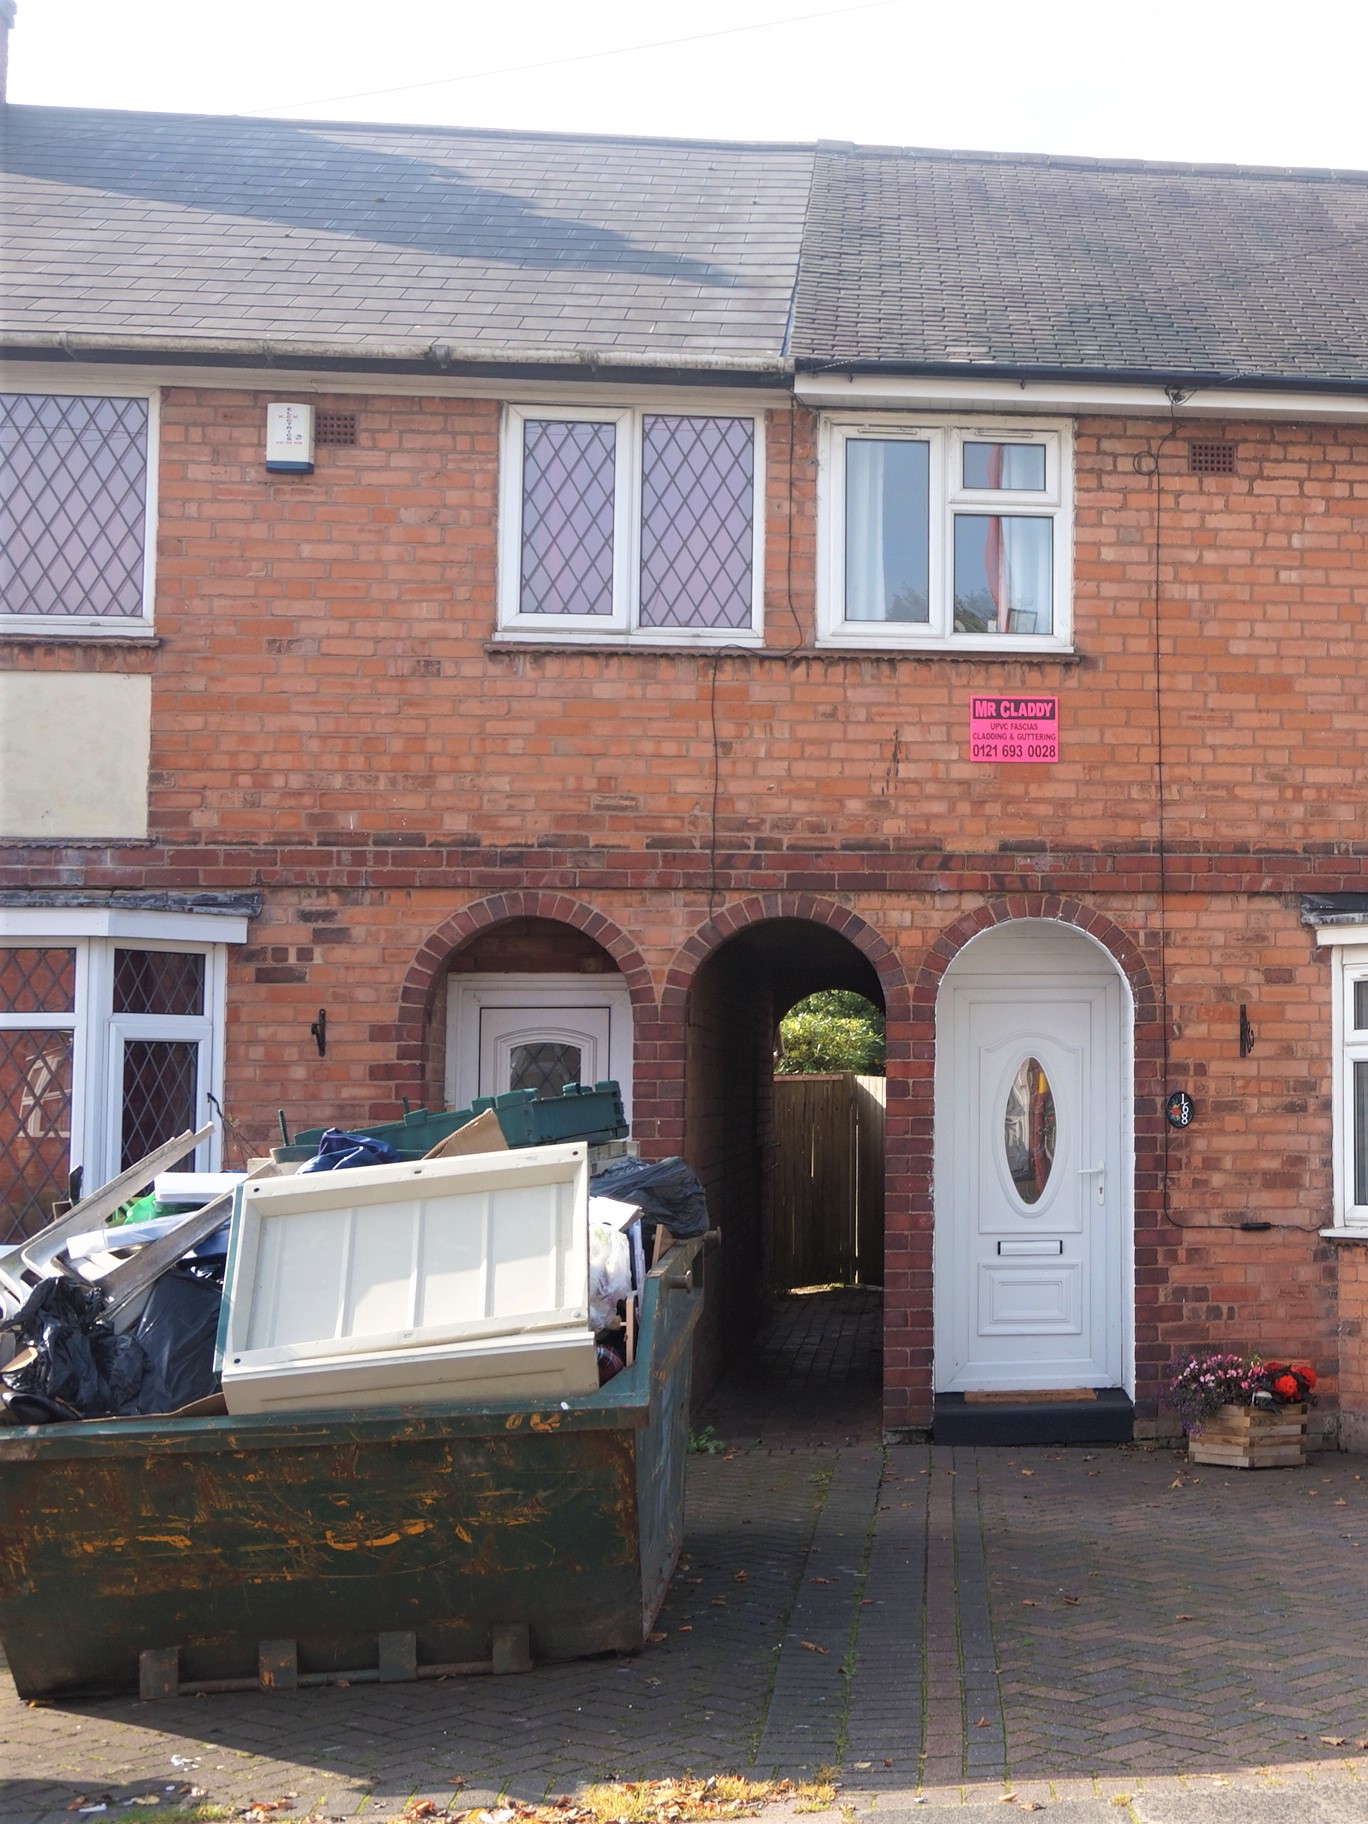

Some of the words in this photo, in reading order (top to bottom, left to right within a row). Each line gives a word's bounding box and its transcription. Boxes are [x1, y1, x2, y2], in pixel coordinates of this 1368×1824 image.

[975, 700, 996, 717] MR
[1000, 700, 1053, 718] CLADDY
[972, 732, 1007, 740] CLADDING
[972, 744, 997, 757] 0121
[1002, 744, 1022, 757] 693
[1027, 745, 1056, 757] 0028
[1180, 1093, 1189, 1125] 168
